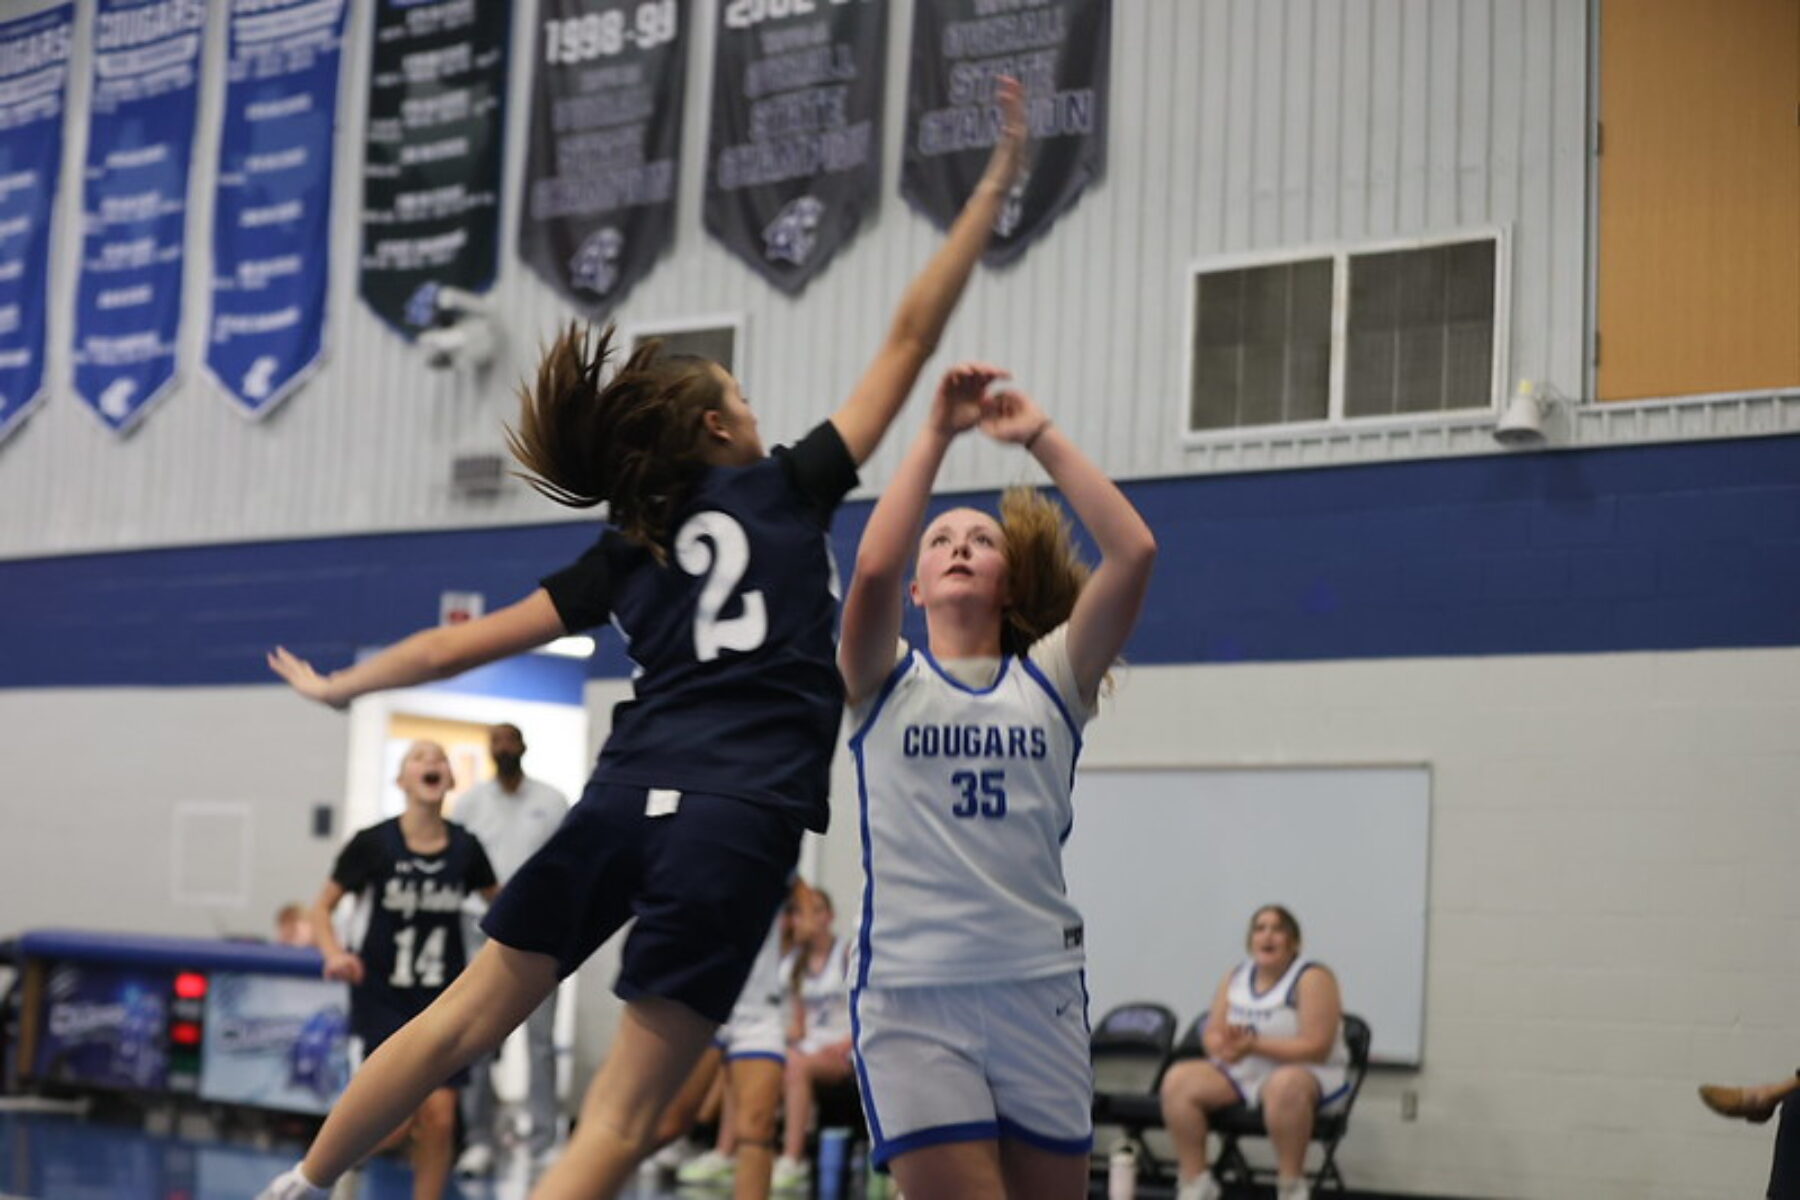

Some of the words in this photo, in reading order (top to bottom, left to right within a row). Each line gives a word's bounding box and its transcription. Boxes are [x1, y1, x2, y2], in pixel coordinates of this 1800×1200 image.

[675, 510, 767, 662] 2
[903, 724, 1047, 759] COUGARS
[951, 770, 1007, 819] 35
[389, 926, 446, 987] 14
